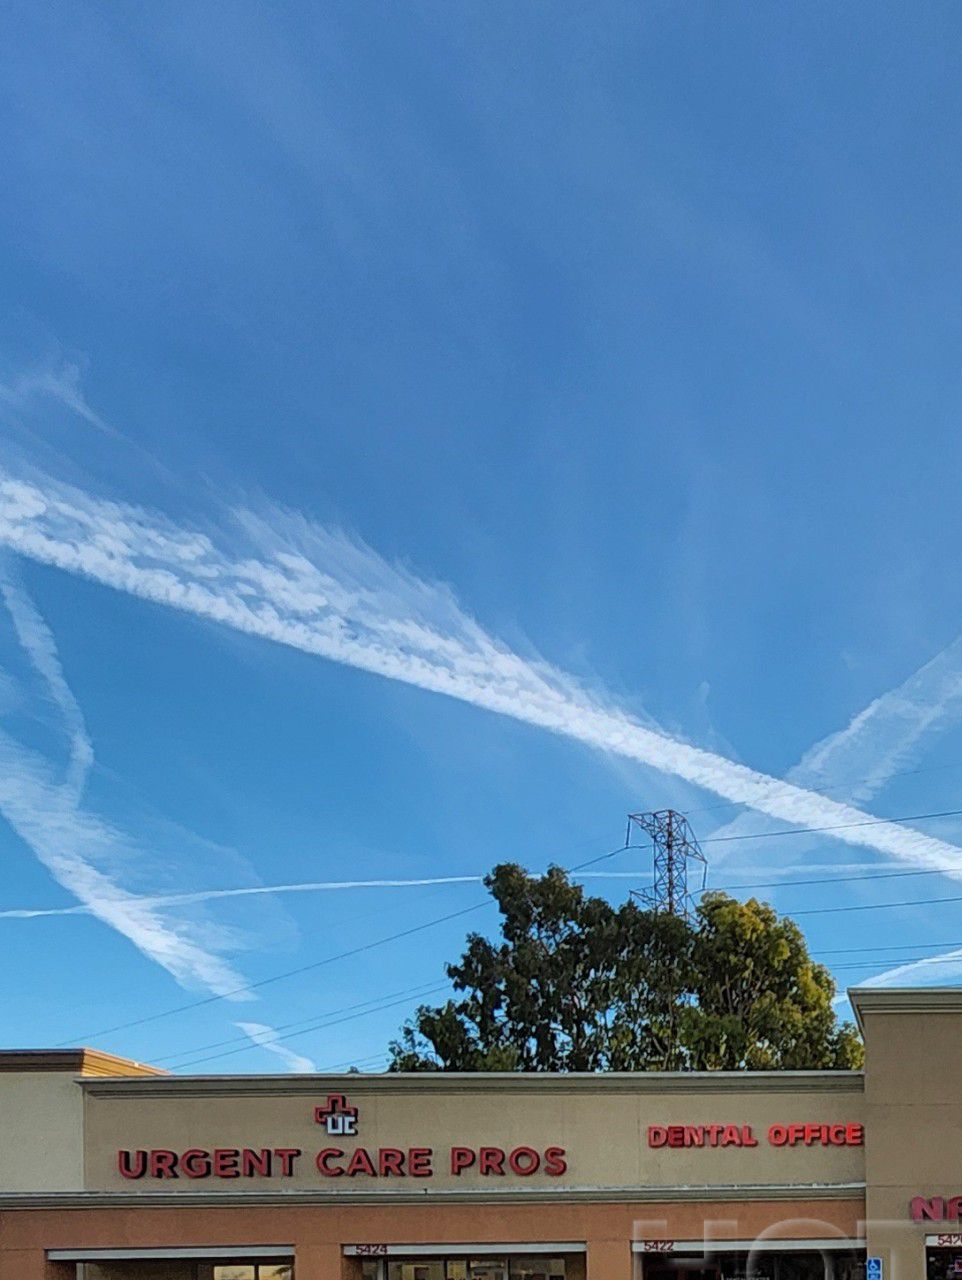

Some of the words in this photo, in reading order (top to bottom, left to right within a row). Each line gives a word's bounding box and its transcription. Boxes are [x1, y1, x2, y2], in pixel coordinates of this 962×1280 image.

[327, 1115, 356, 1135] UC
[648, 1125, 758, 1148] DENTAL
[767, 1123, 864, 1147] OFFICE
[118, 1149, 300, 1179] URGENT
[315, 1148, 433, 1177] CARE
[450, 1147, 567, 1176] PROS
[355, 1244, 388, 1255] 5424
[644, 1240, 674, 1251] 5422
